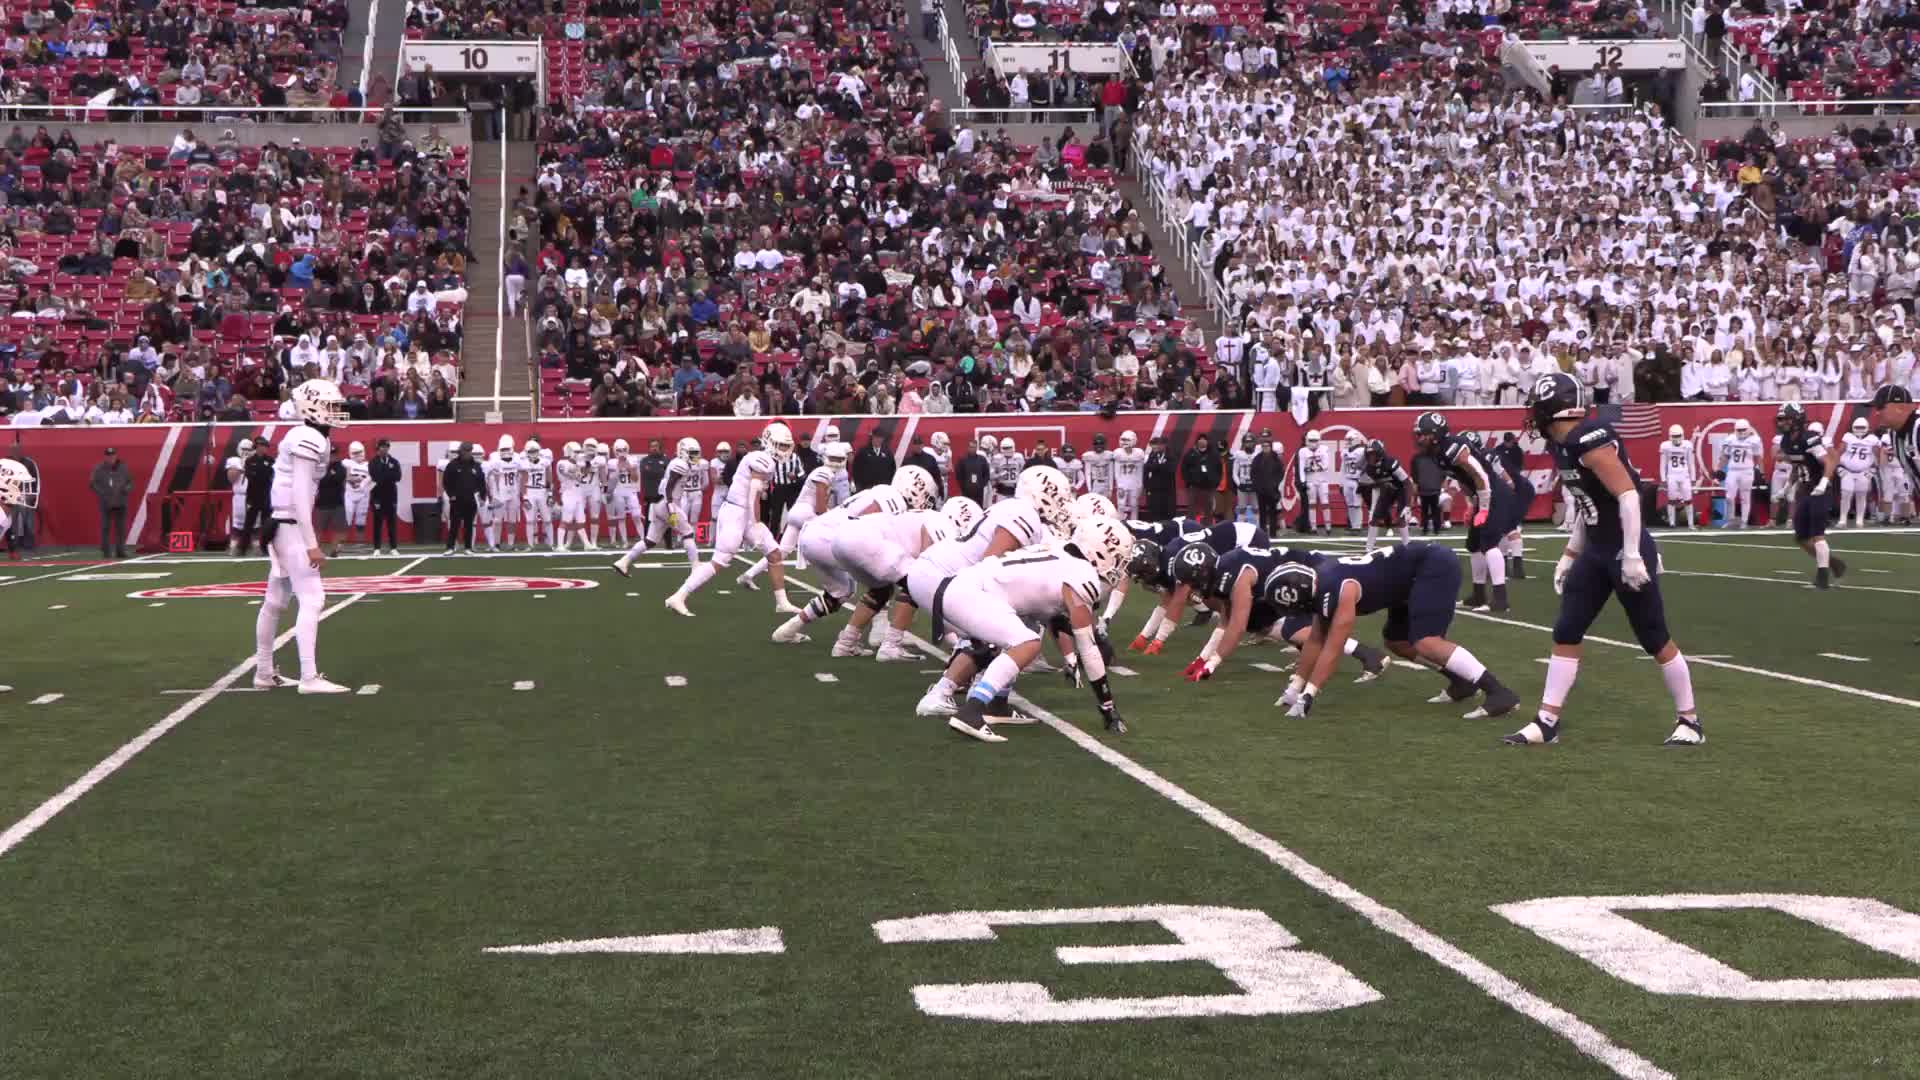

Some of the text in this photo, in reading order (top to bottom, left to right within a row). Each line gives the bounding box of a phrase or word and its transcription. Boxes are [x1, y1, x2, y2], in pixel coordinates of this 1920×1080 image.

[460, 48, 488, 69] 10
[1048, 50, 1070, 71] 11
[1596, 46, 1623, 66] 12
[1850, 446, 1867, 460] 76
[171, 534, 190, 548] 20
